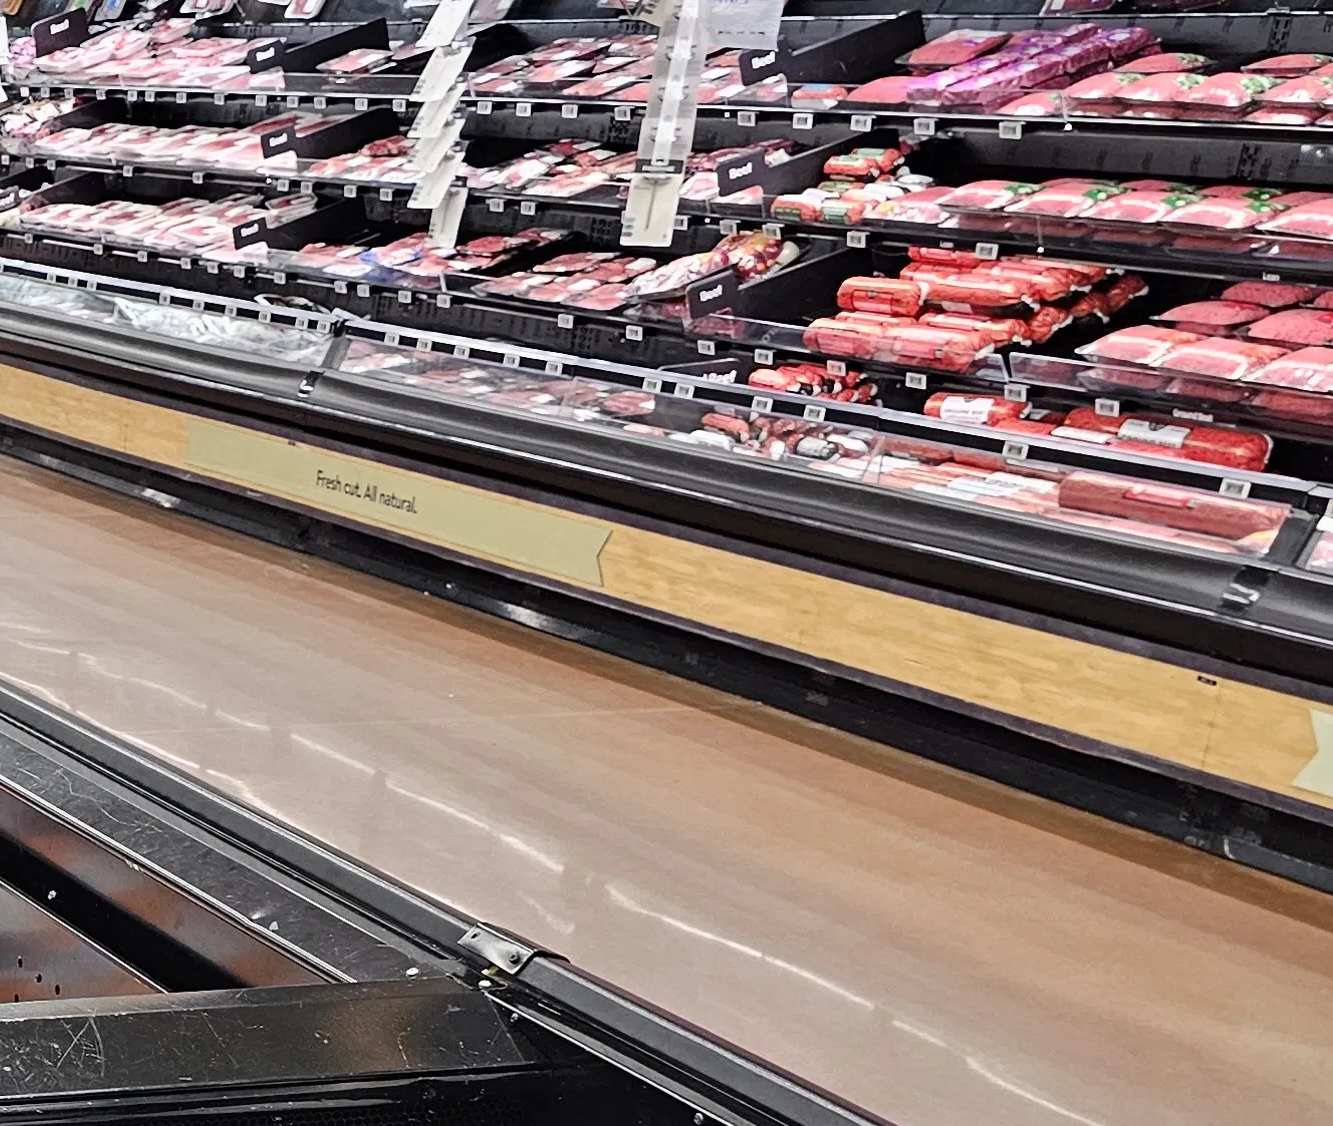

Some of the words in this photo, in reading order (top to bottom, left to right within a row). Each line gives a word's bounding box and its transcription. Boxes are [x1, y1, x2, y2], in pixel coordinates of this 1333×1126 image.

[751, 51, 776, 69] Beef
[728, 162, 753, 179] Beef
[699, 284, 723, 301] Beef
[316, 469, 341, 492] Fresh
[344, 480, 362, 498] cut.
[363, 486, 378, 502] All
[378, 492, 418, 514] natural.
